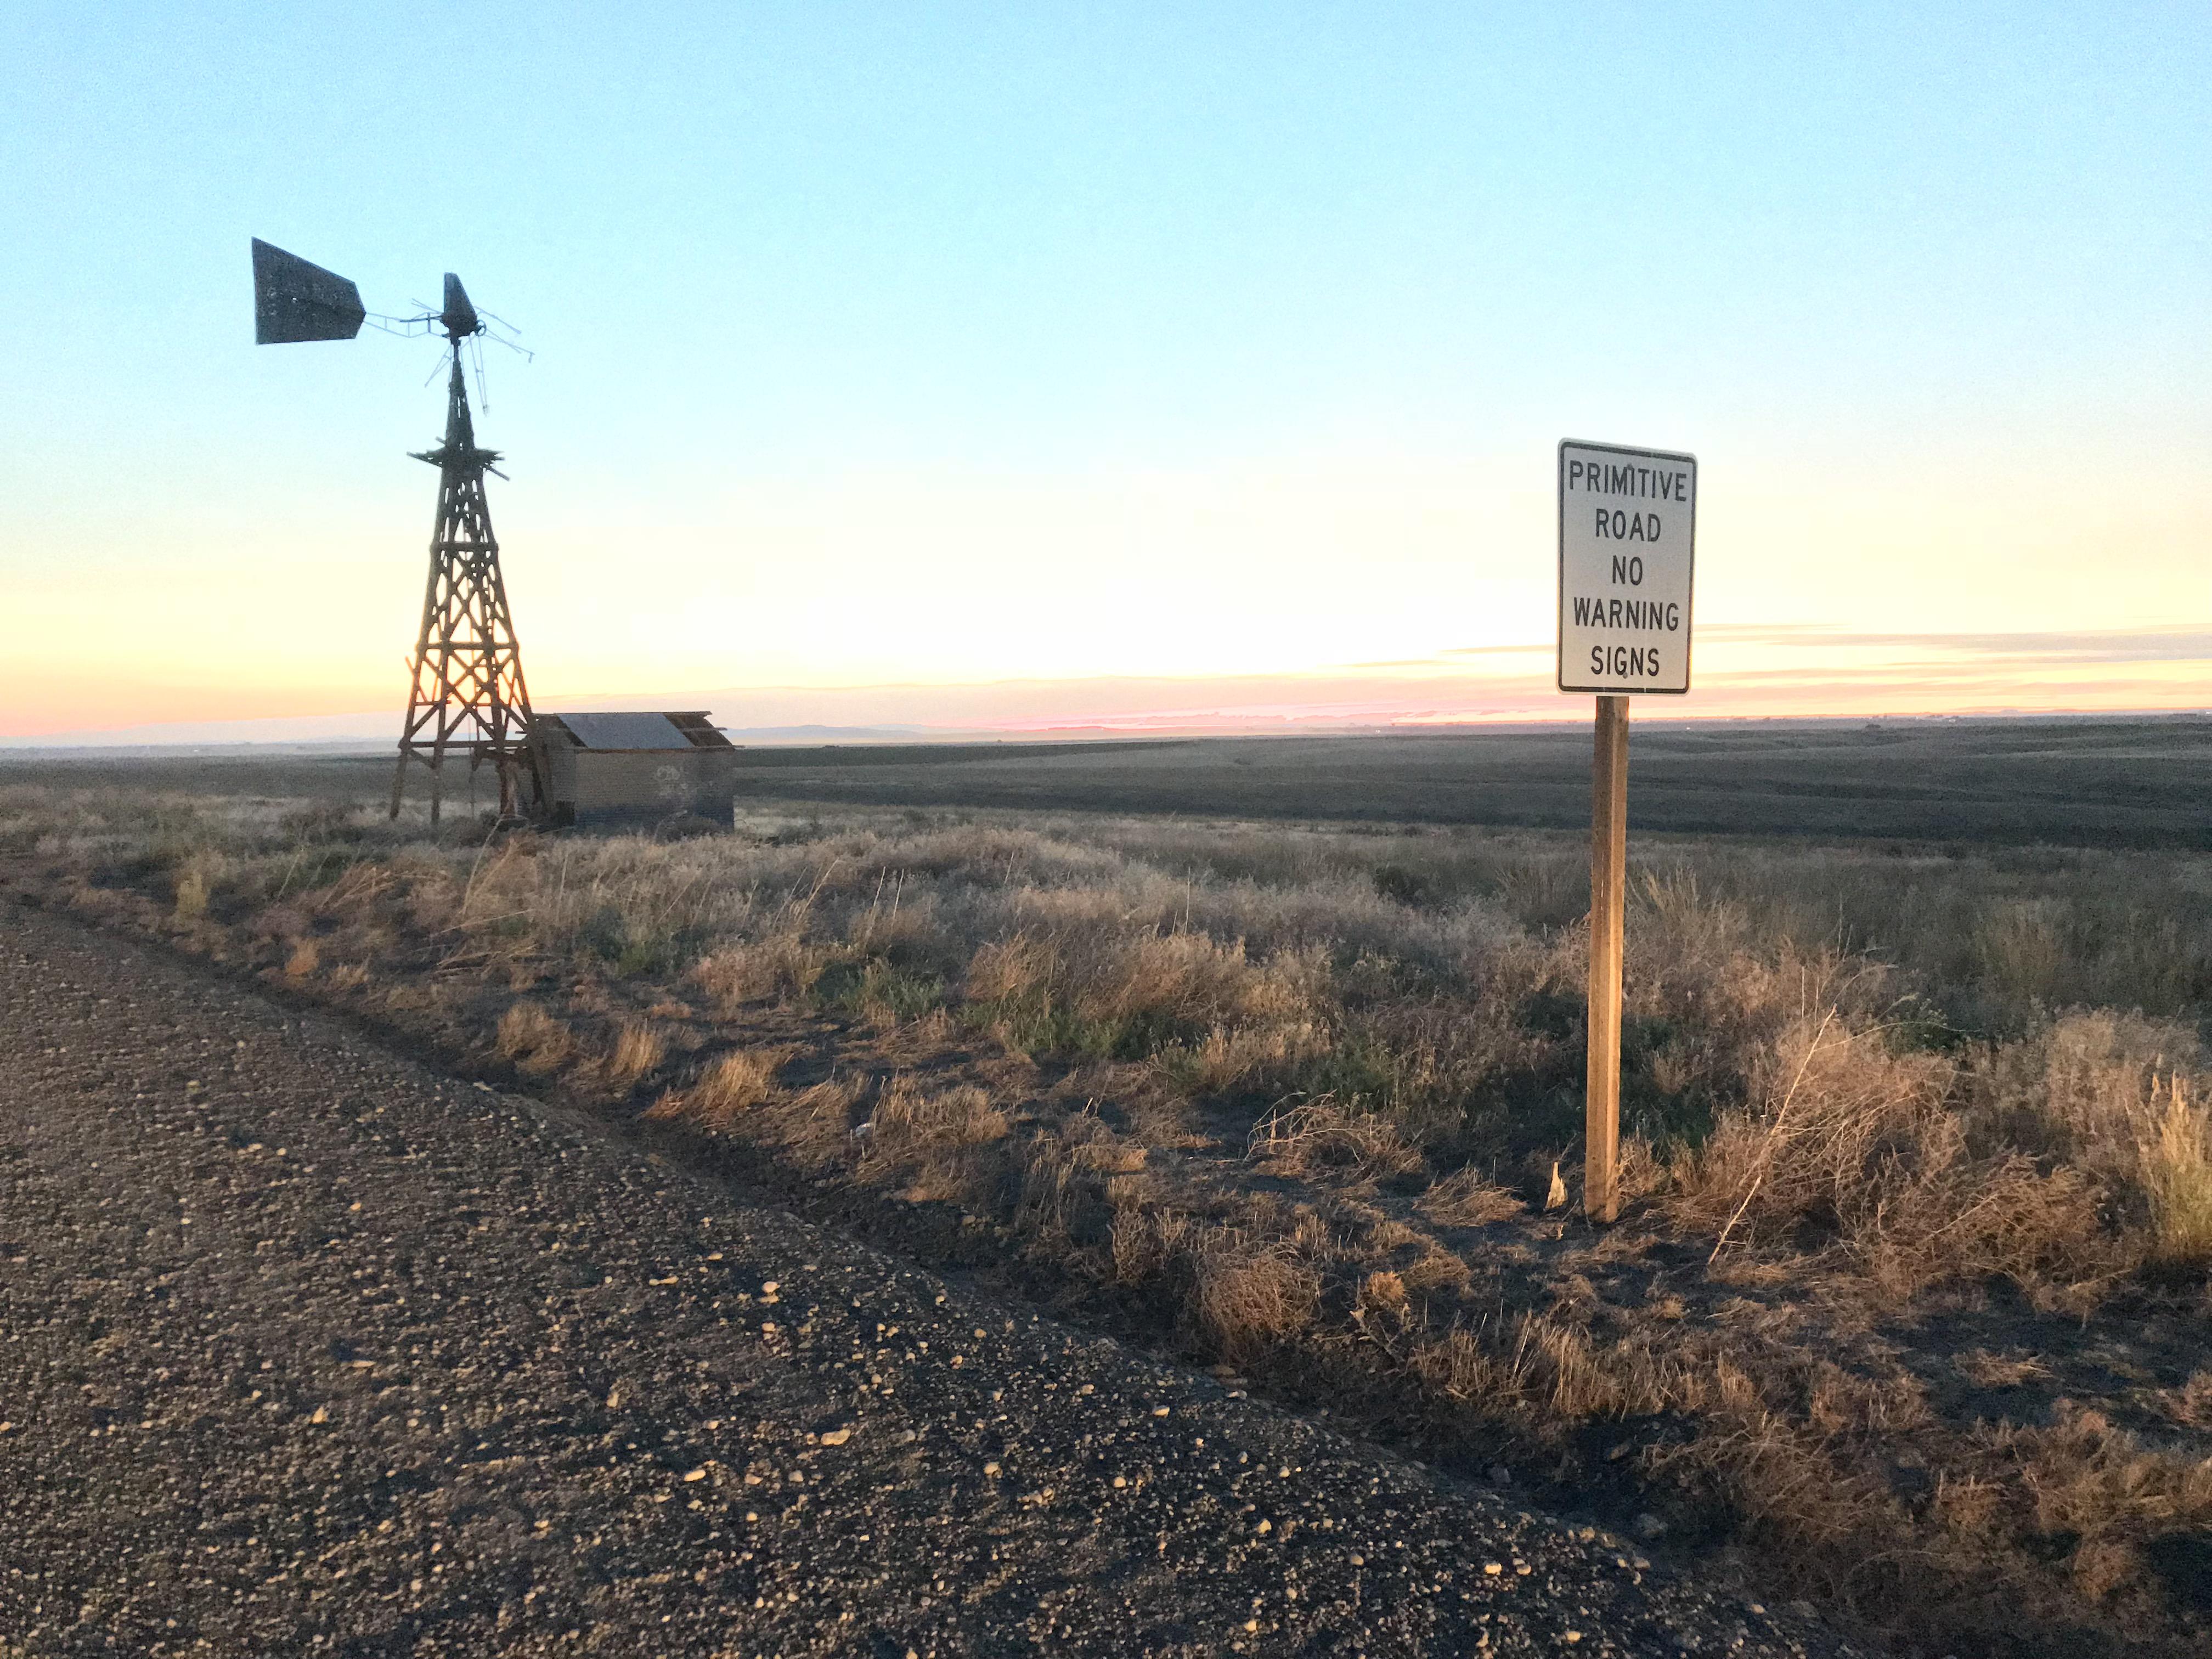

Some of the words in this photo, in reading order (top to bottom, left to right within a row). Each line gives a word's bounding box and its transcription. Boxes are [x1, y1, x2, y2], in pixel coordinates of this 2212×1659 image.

[1570, 460, 1687, 502] PRIMITIVE
[1595, 508, 1661, 542] ROAD
[1612, 555, 1643, 586] NO
[1573, 596, 1679, 631] WARNING
[1590, 645, 1660, 676] SIGNS
